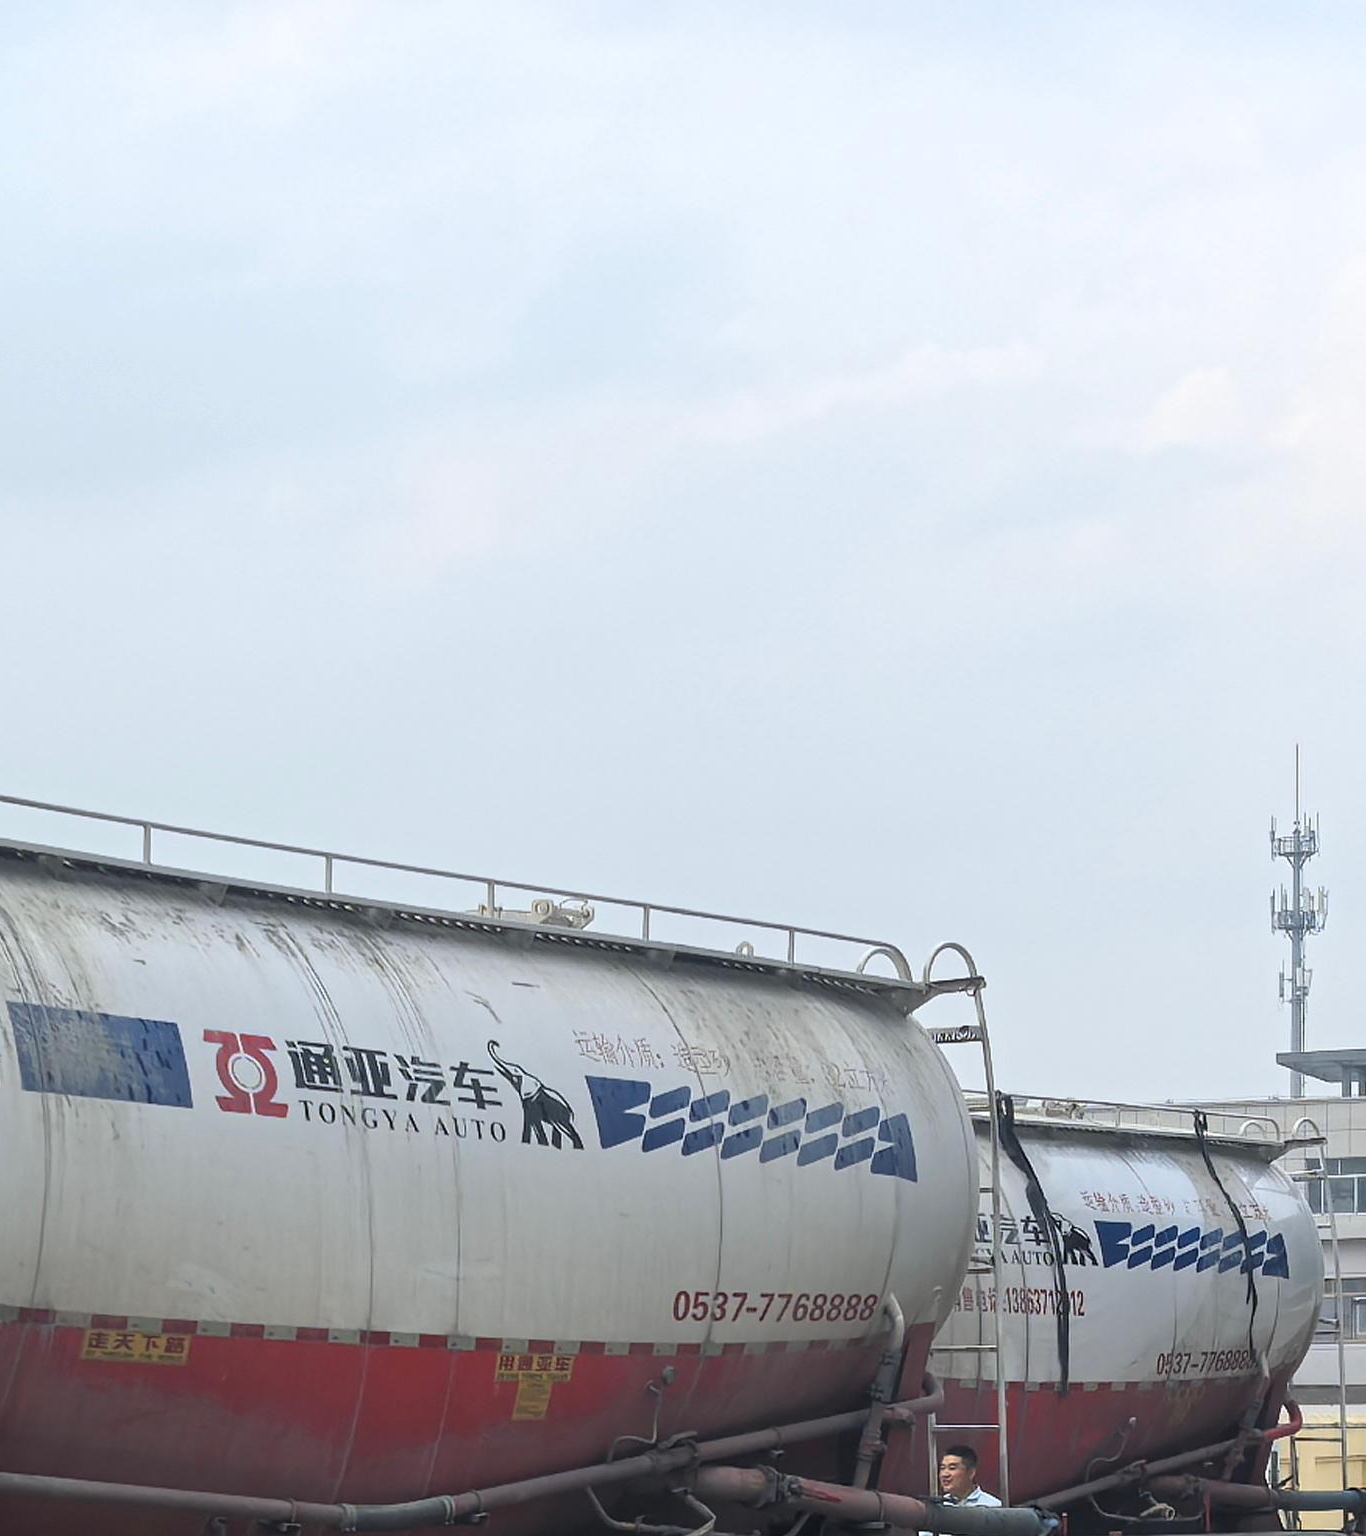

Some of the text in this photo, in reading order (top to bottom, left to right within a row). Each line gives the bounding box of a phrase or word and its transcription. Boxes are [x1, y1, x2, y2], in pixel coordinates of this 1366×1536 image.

[285, 1040, 503, 1110] 通亚汽车
[298, 1099, 507, 1143] TONGYA AUTO
[673, 1290, 877, 1322] 0537-7768888
